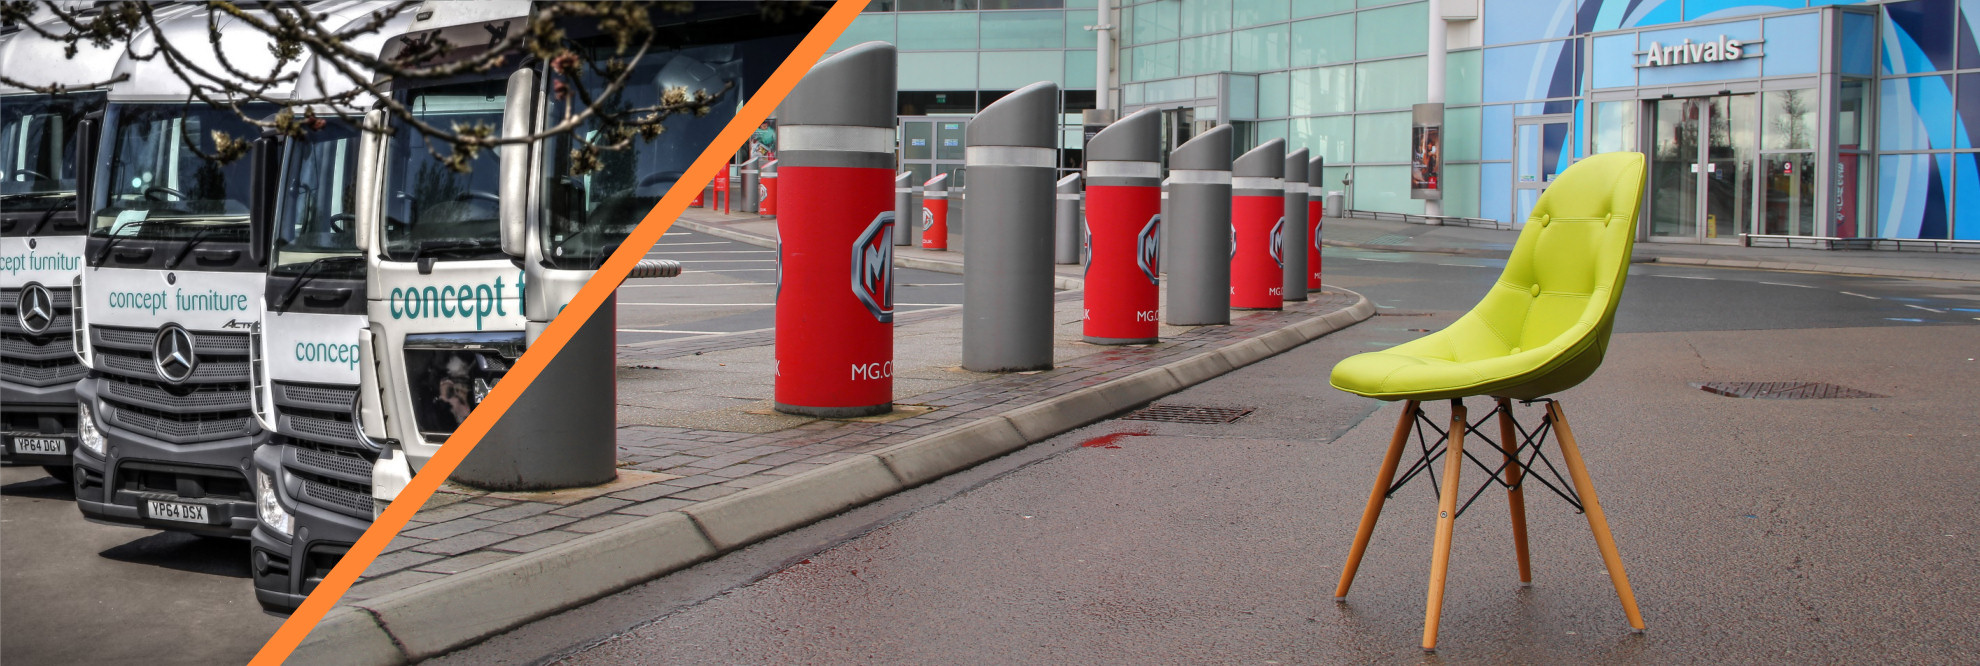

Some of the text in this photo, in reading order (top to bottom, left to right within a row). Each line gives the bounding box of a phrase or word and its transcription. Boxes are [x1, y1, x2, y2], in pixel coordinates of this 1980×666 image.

[1645, 35, 1744, 66] Arrivals
[109, 288, 248, 316] concept furniture
[390, 276, 507, 331] concept
[296, 342, 360, 371] concep
[18, 438, 42, 451] YP64
[152, 501, 204, 520] YP64 DSX
